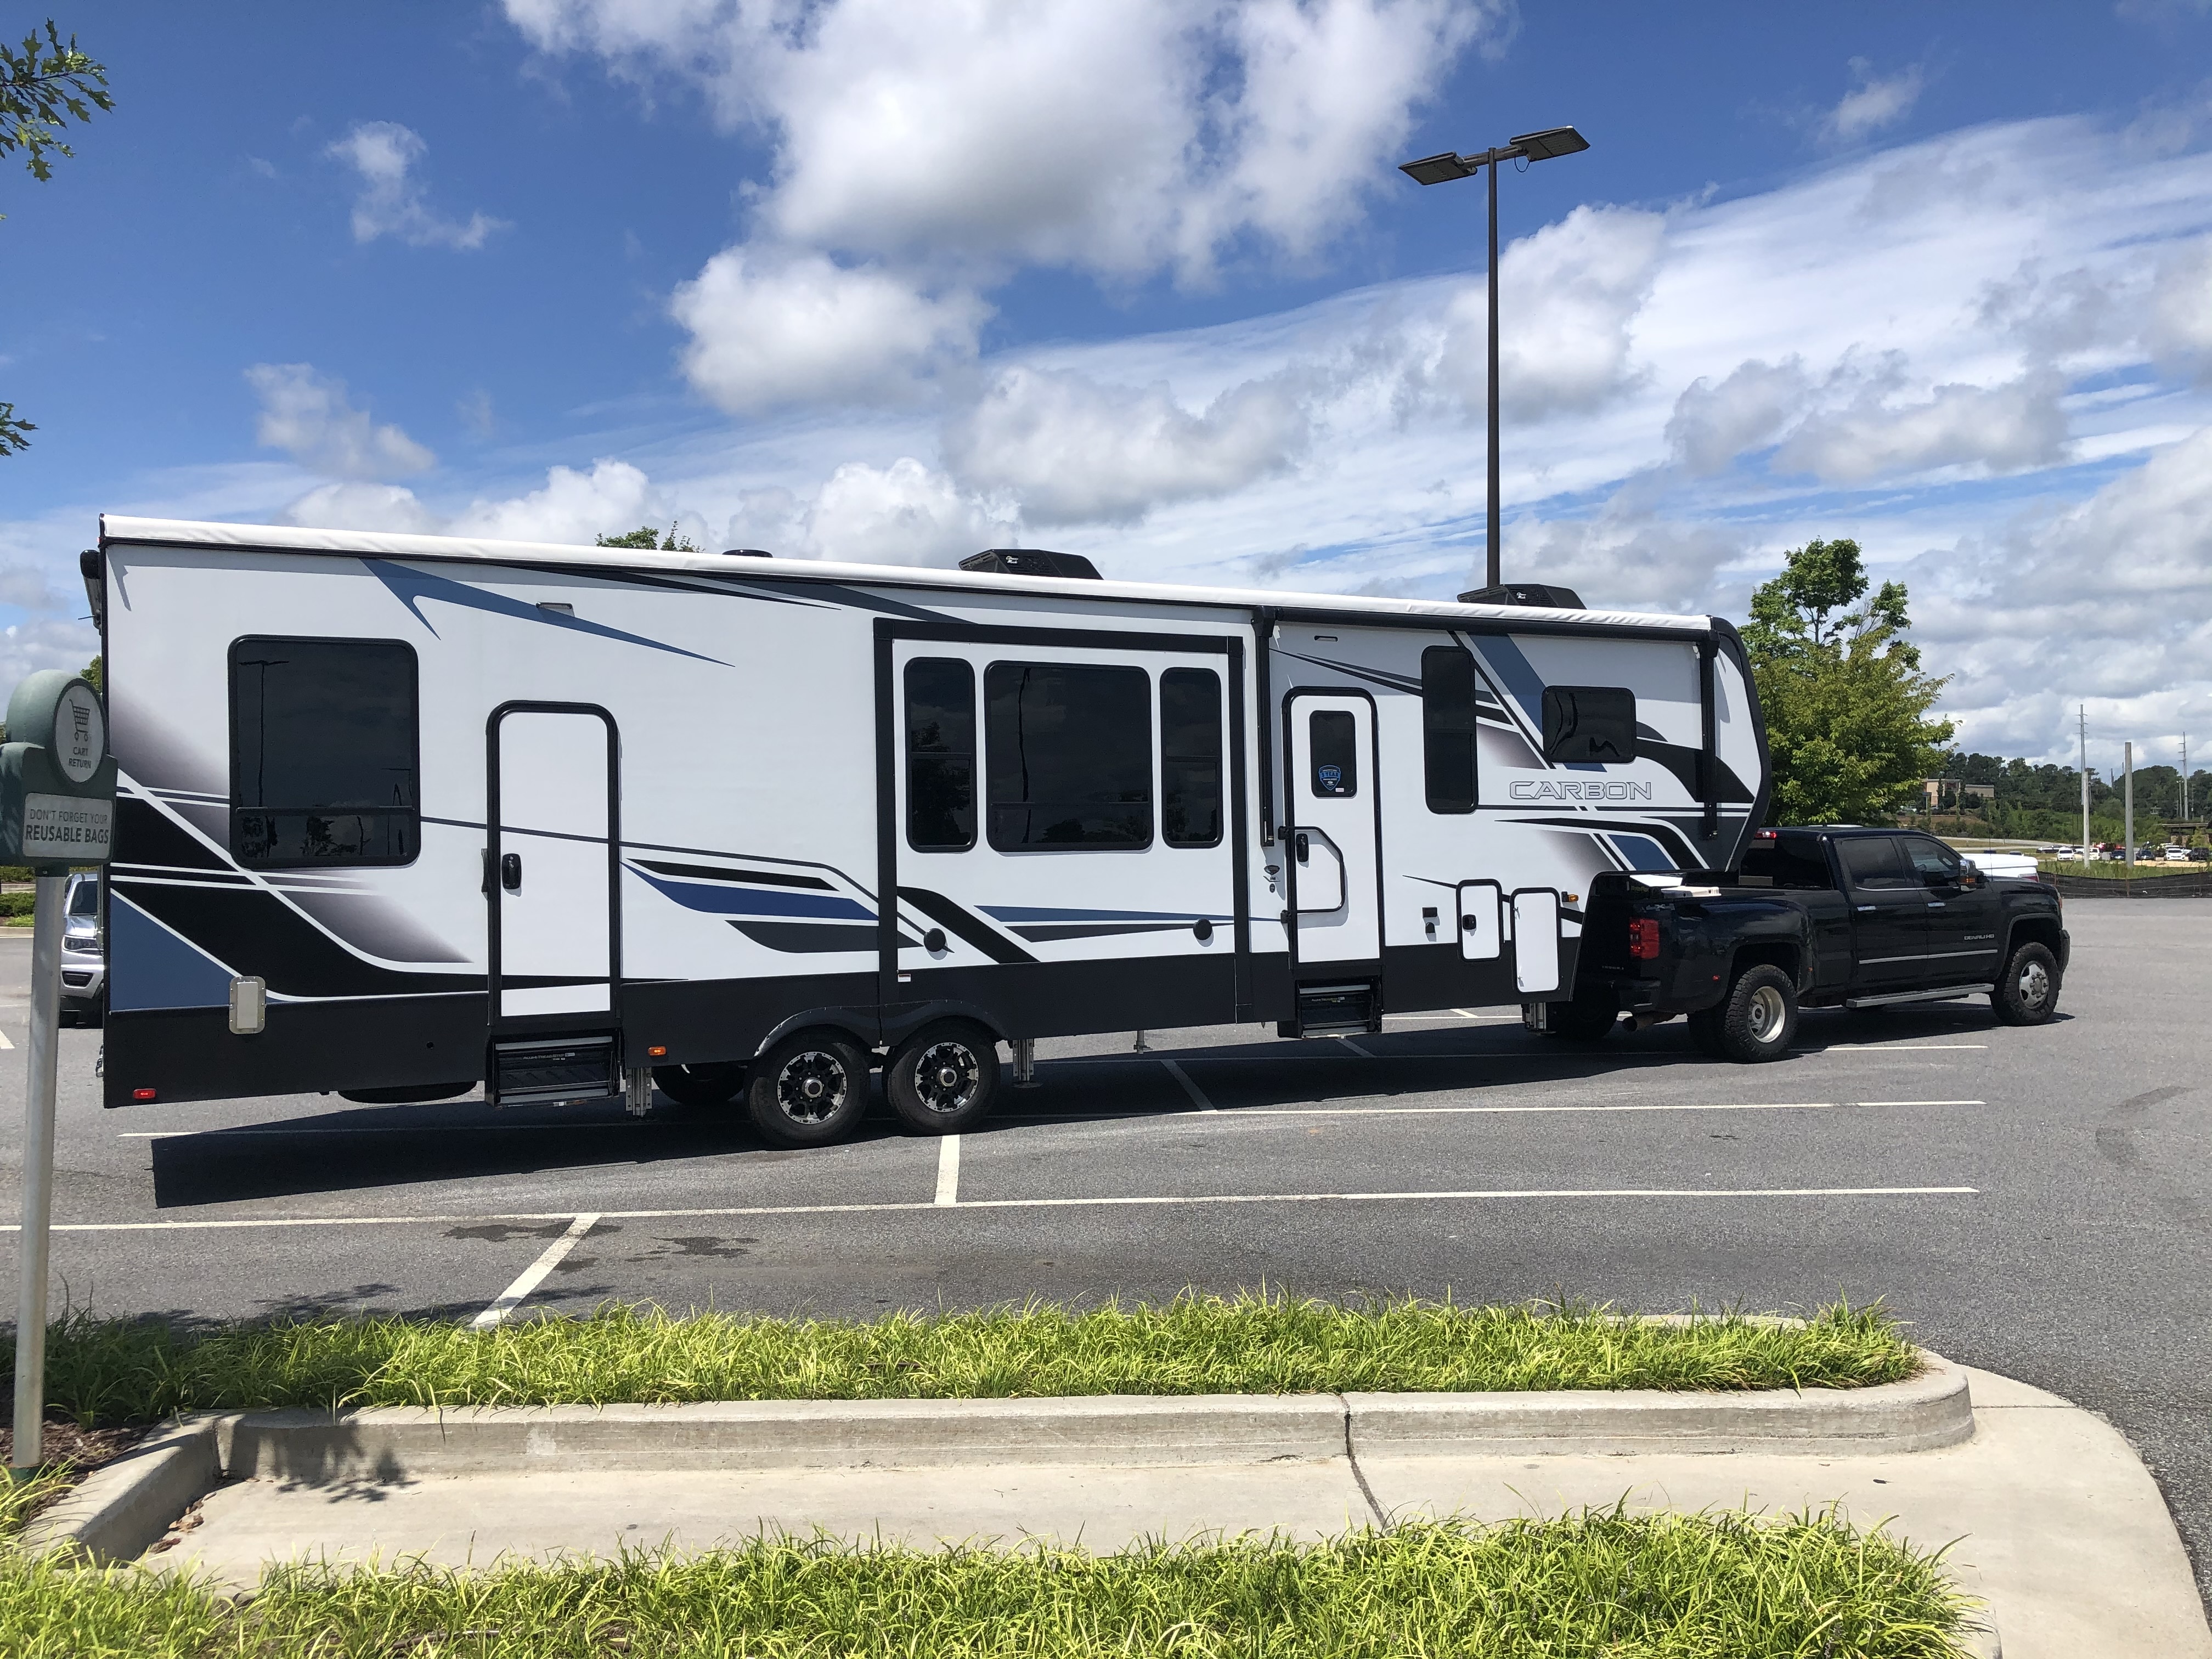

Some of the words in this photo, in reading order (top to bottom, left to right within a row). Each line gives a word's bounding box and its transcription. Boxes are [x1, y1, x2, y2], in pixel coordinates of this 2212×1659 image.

[73, 746, 88, 756] CART
[69, 758, 92, 769] RETURN
[1509, 781, 1652, 800] CARBON
[30, 809, 57, 820] DON'T
[59, 811, 88, 823] FORGET
[90, 813, 108, 824] YOUR
[26, 825, 82, 843] REUSABLE
[84, 828, 109, 844] BAGS
